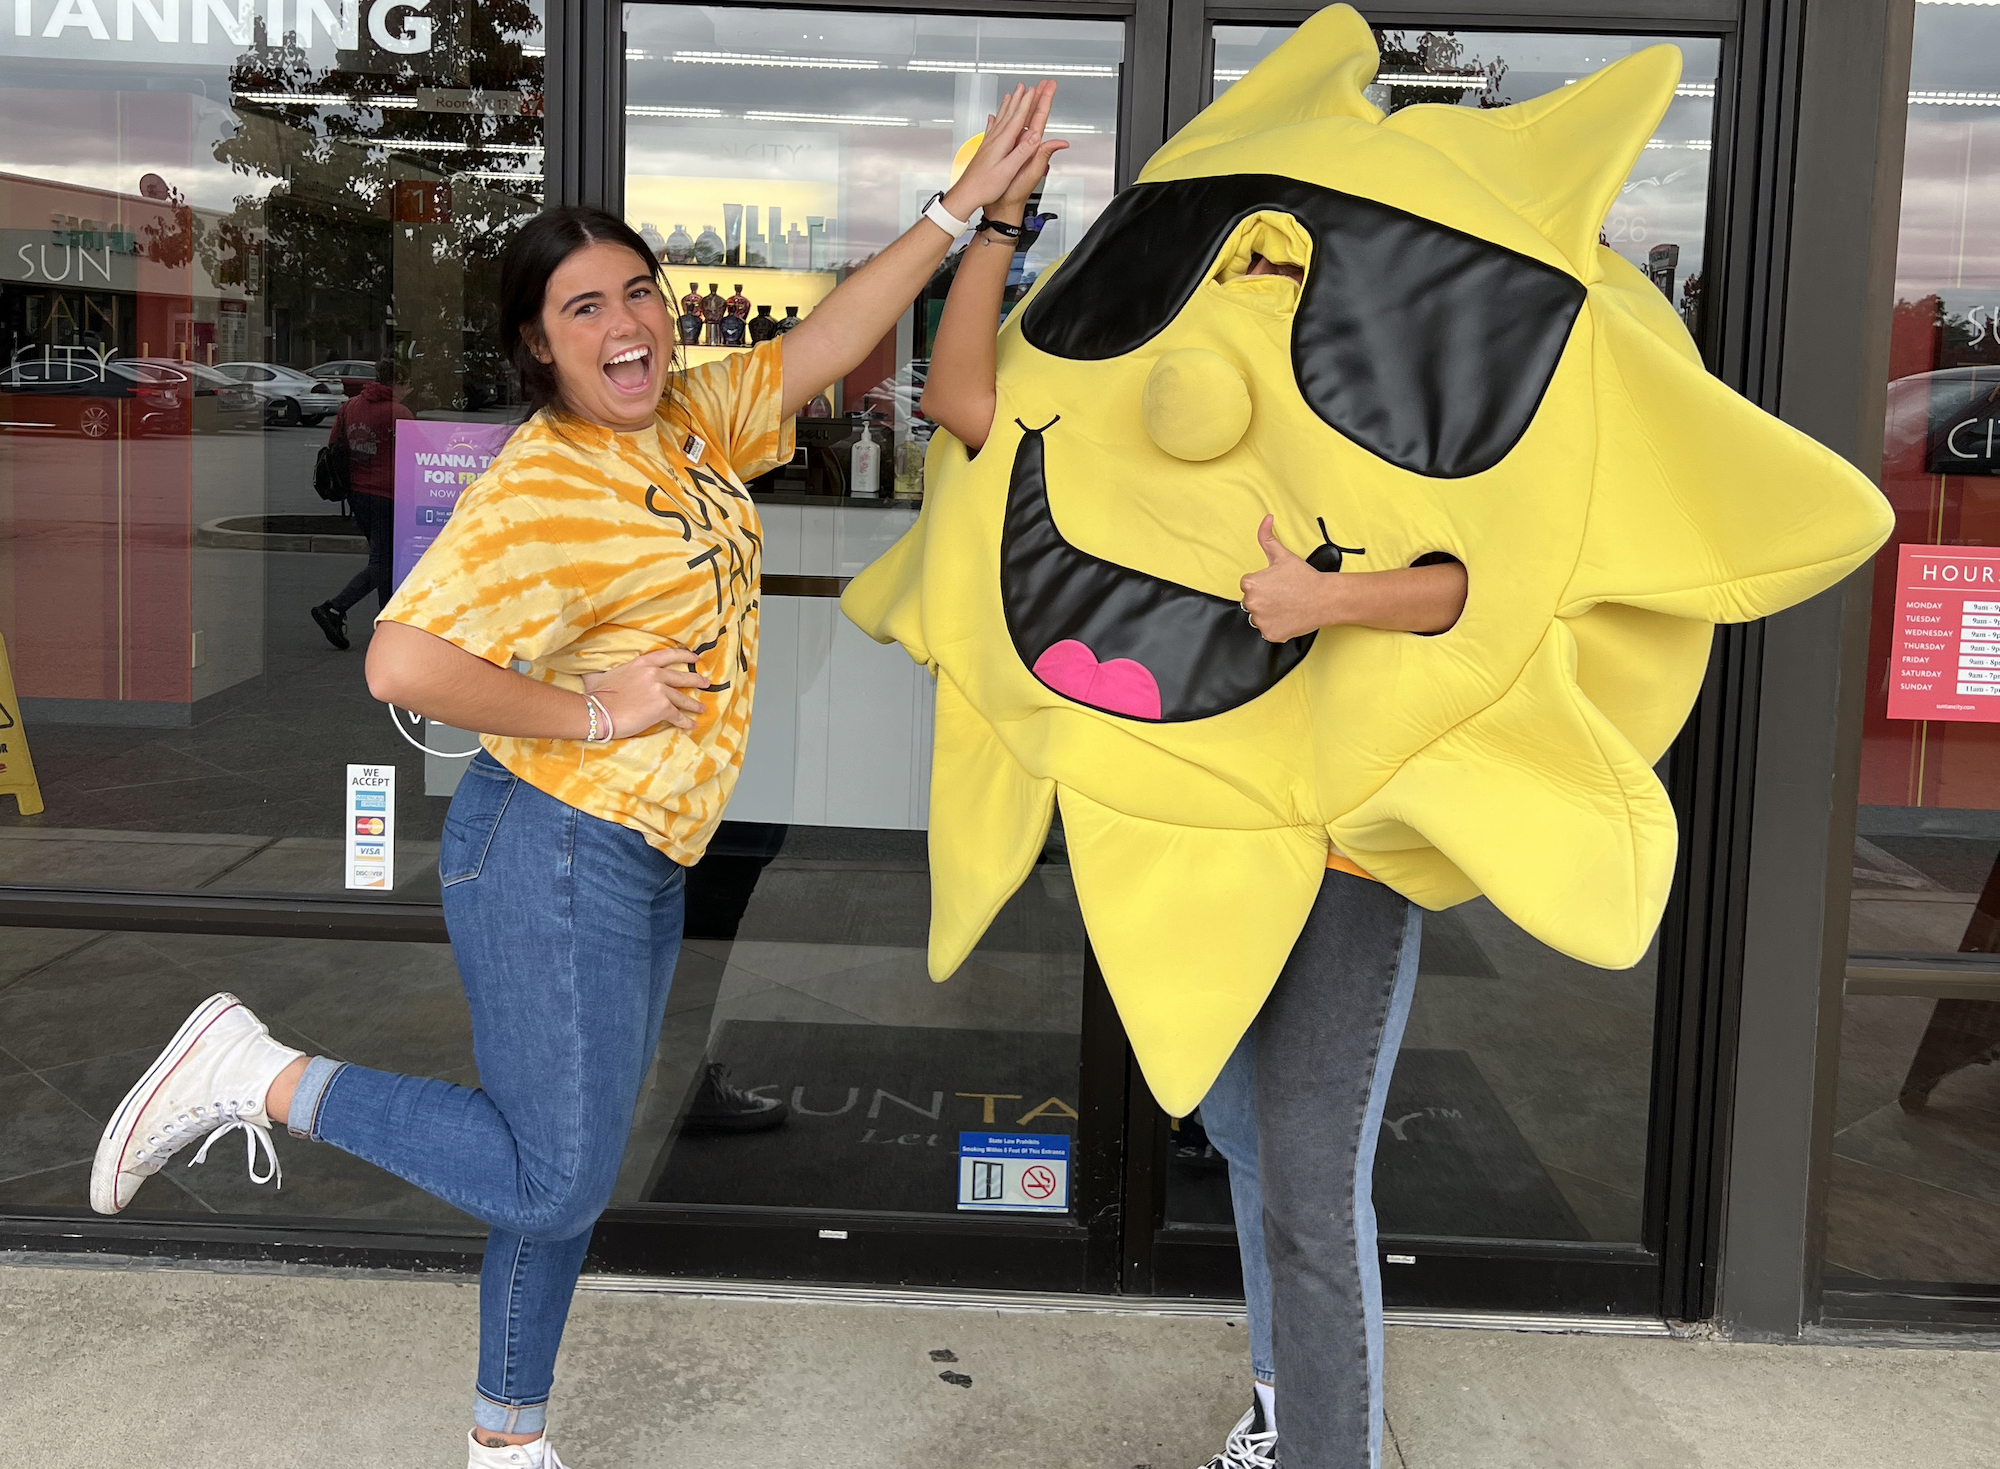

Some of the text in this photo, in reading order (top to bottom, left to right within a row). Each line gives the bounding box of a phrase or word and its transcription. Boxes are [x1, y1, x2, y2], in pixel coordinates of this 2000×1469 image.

[18, 243, 111, 281] SUN
[14, 343, 119, 383] CITY
[1947, 417, 2000, 459] CI
[414, 452, 476, 468] WANNA
[424, 470, 482, 485] FOR FR
[430, 489, 456, 498] NOW
[645, 462, 749, 542] SUN
[1923, 564, 2000, 583] HOUR
[1906, 601, 1943, 609] MONDAY
[1905, 615, 1941, 623] TUESDAY
[1904, 629, 1954, 637] WEDNESDAY
[1992, 631, 2000, 640] 9p
[1903, 642, 1946, 650] THURSDAY
[1991, 645, 2000, 653] 9p
[1901, 669, 1942, 677] SATURDAY
[1968, 671, 1983, 679] 9am
[1900, 683, 1933, 691] SUNDAY
[363, 768, 380, 777] WE
[352, 777, 390, 787] ACCEPT
[361, 847, 381, 855] VISA
[955, 1092, 1079, 1126] TA
[1041, 1148, 1066, 1156] Entrance
